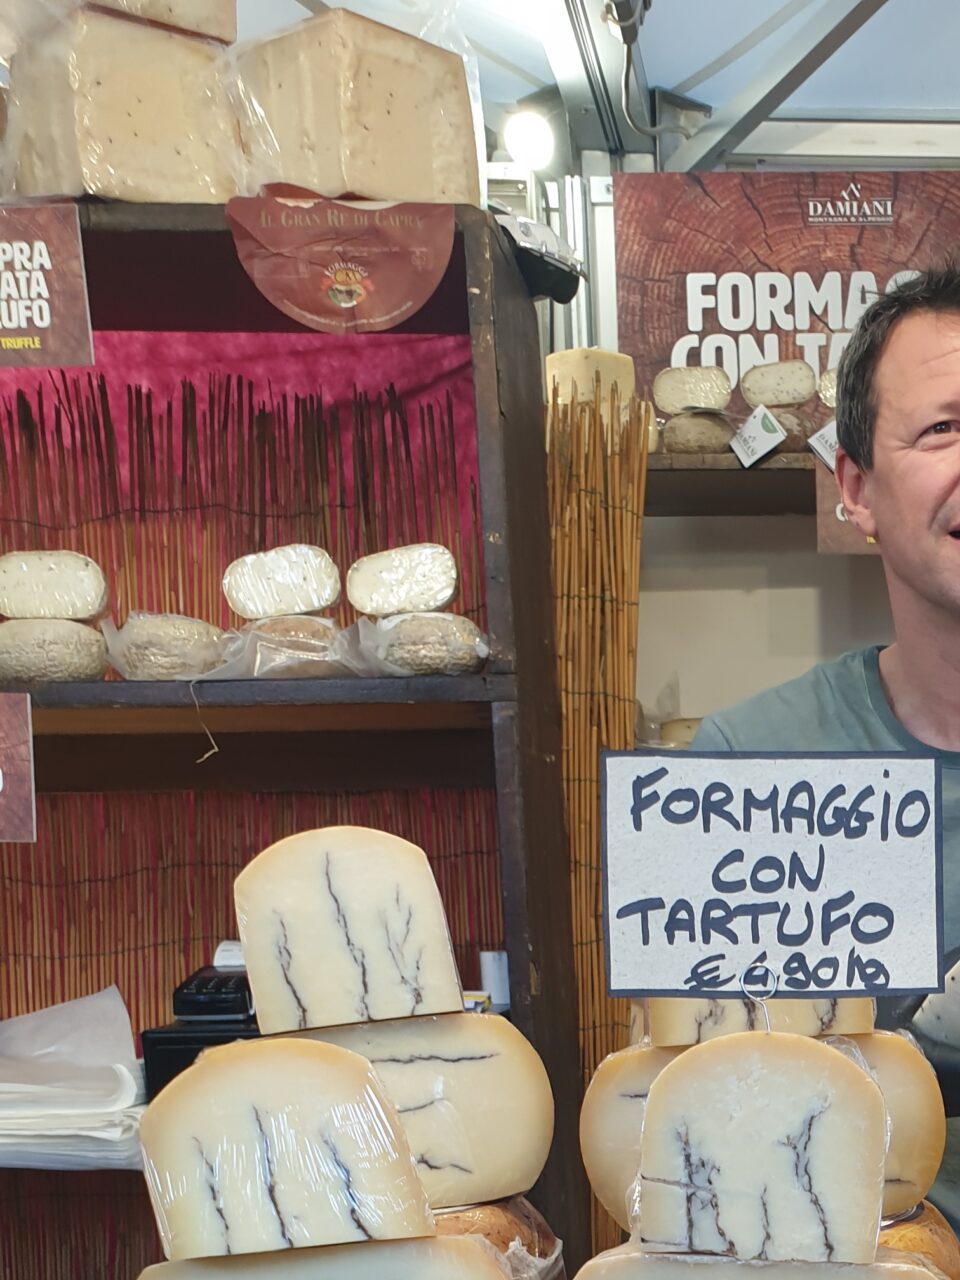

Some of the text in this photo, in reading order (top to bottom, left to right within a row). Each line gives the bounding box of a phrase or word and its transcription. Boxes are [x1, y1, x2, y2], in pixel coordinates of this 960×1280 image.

[807, 200, 893, 216] DAMIANI
[686, 270, 926, 332] FORMA
[1, 336, 41, 350] TRUFFLE
[711, 843, 826, 894] CON
[616, 890, 894, 947] TARTUFO
